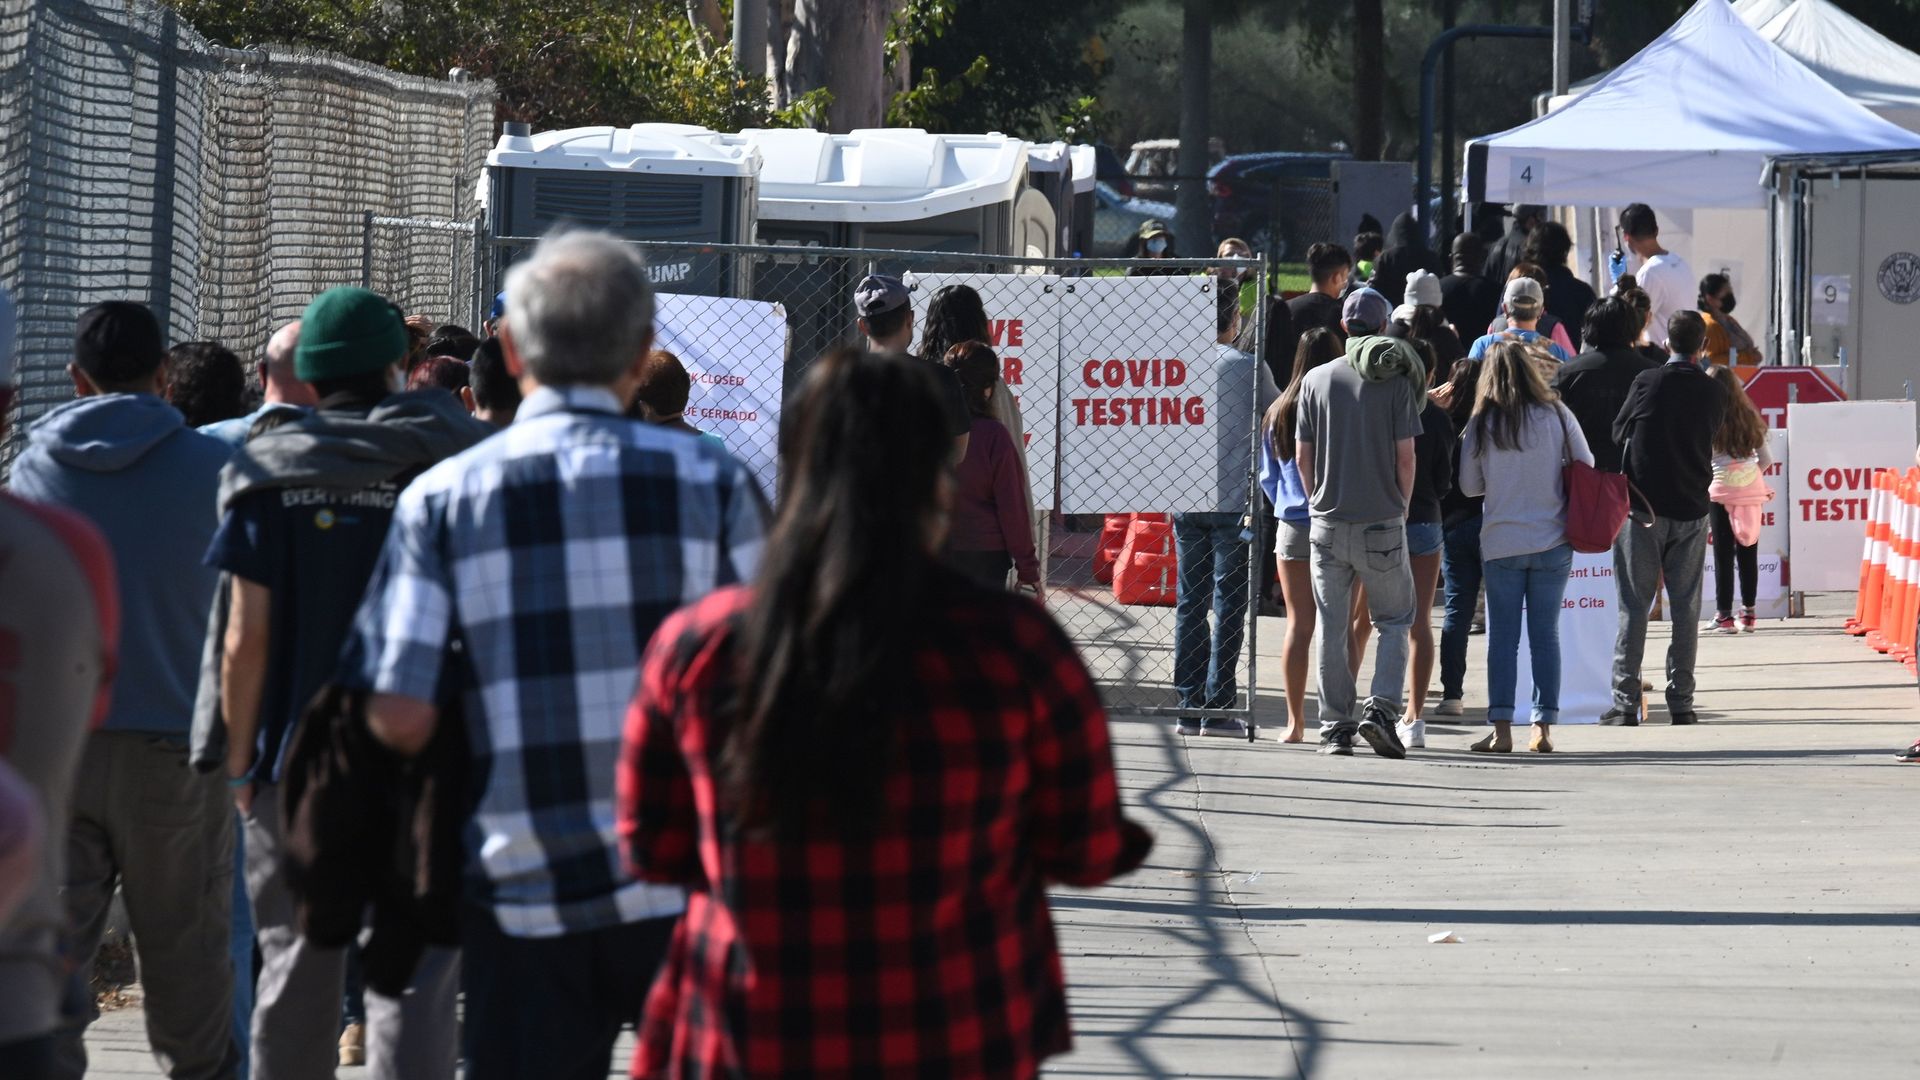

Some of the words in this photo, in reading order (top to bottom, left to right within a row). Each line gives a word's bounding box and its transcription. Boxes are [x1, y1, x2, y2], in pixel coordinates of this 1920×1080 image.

[1520, 165, 1532, 183] 4
[647, 262, 691, 283] UMP
[1824, 285, 1837, 304] 9
[987, 319, 1023, 347] VE
[701, 374, 745, 386] CLOSED
[1082, 359, 1186, 388] COVID
[701, 408, 757, 422] CERRADO
[1072, 397, 1205, 426] TESTING
[1807, 467, 1888, 491] COVI
[1798, 498, 1869, 522] TESTI
[1569, 567, 1588, 578] ent
[1592, 566, 1613, 577] Lin
[1579, 597, 1605, 608] Cita
